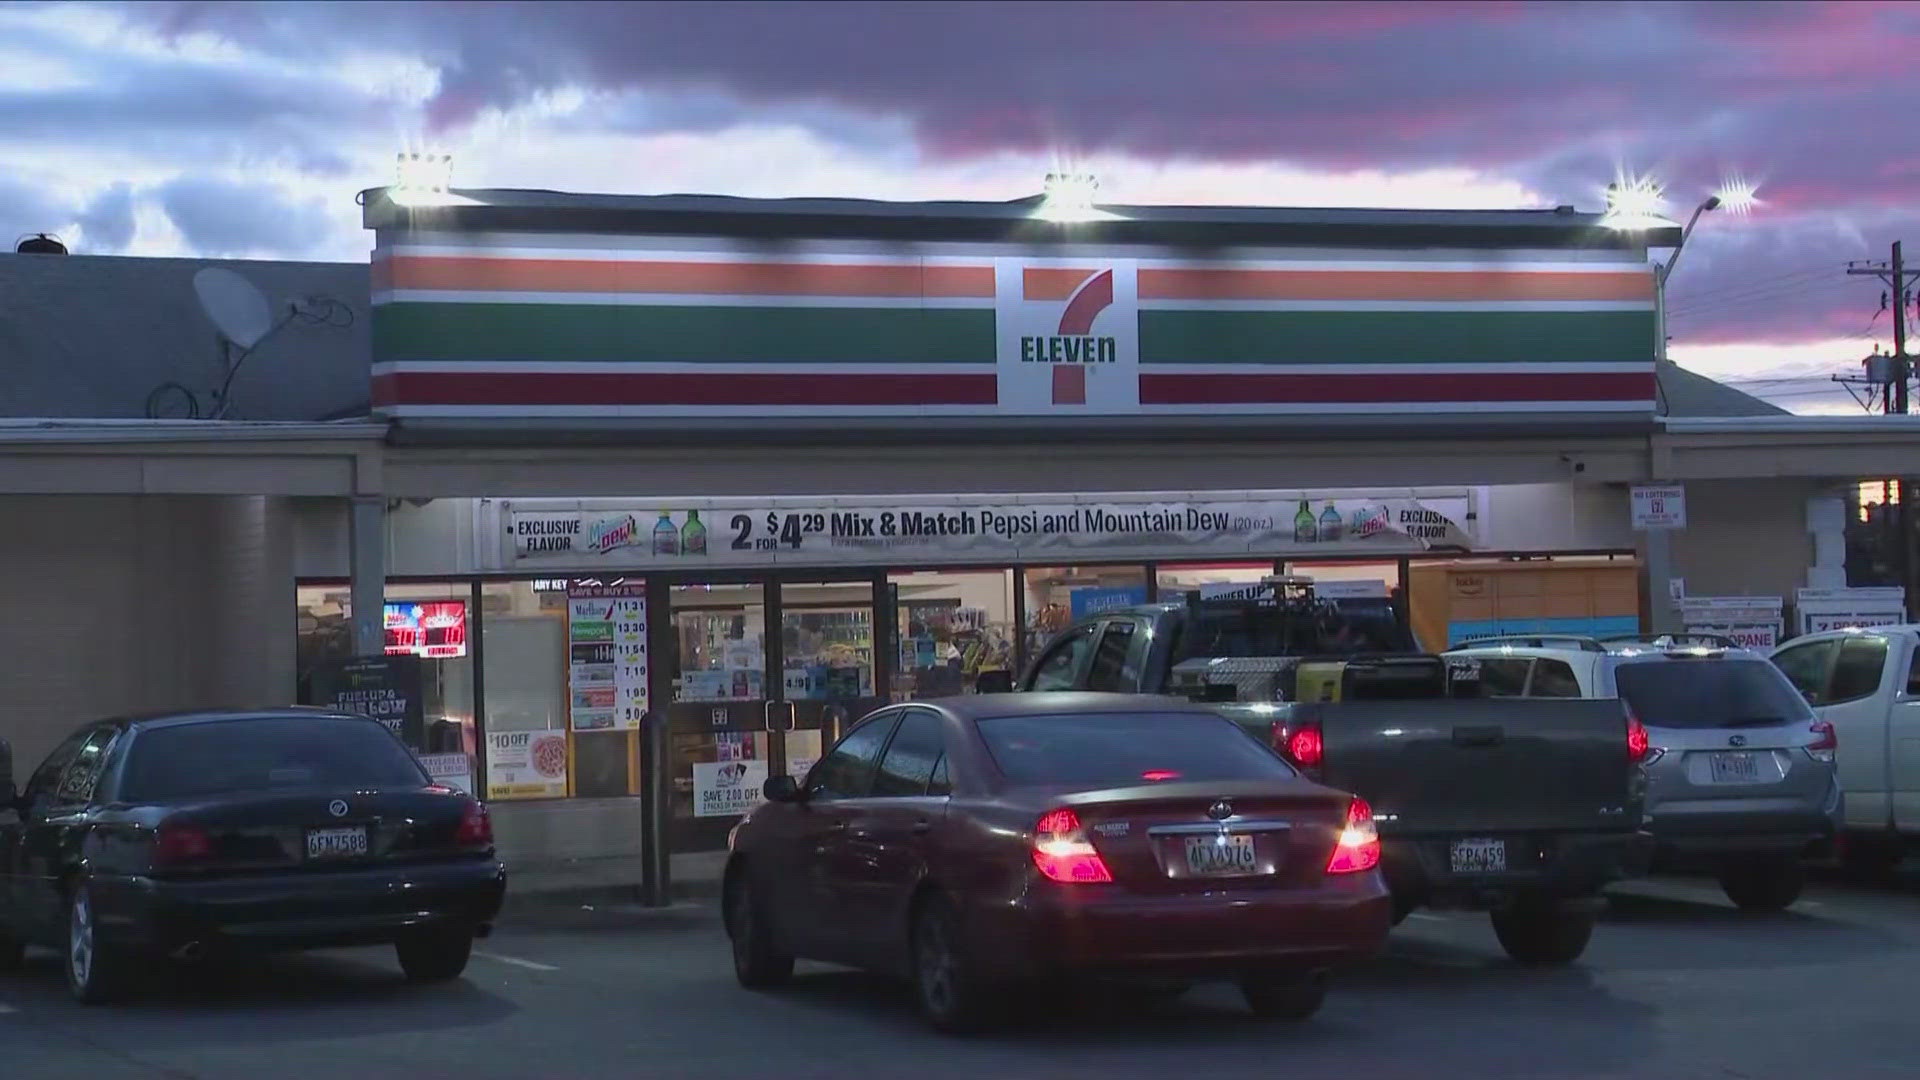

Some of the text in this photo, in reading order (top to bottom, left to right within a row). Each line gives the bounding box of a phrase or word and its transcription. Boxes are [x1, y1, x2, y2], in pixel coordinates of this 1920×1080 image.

[1022, 267, 1114, 405] 7
[1400, 509, 1455, 526] EXCLUSIV
[517, 520, 580, 536] EXCLUSIVE
[730, 513, 752, 550] 2
[756, 538, 778, 551] FOR
[830, 512, 875, 538] Mix
[879, 511, 897, 537] &
[901, 510, 976, 537] Match
[981, 509, 1038, 540] Pepsi
[1042, 510, 1080, 534] and
[1085, 508, 1182, 534] Mountain
[1187, 507, 1229, 532] Dew
[526, 536, 571, 552] FLAVOR
[552, 579, 568, 590] KEY
[1246, 584, 1266, 600] UP
[510, 732, 530, 746] OFF
[703, 790, 721, 802] SAVE
[744, 788, 759, 801] OFF
